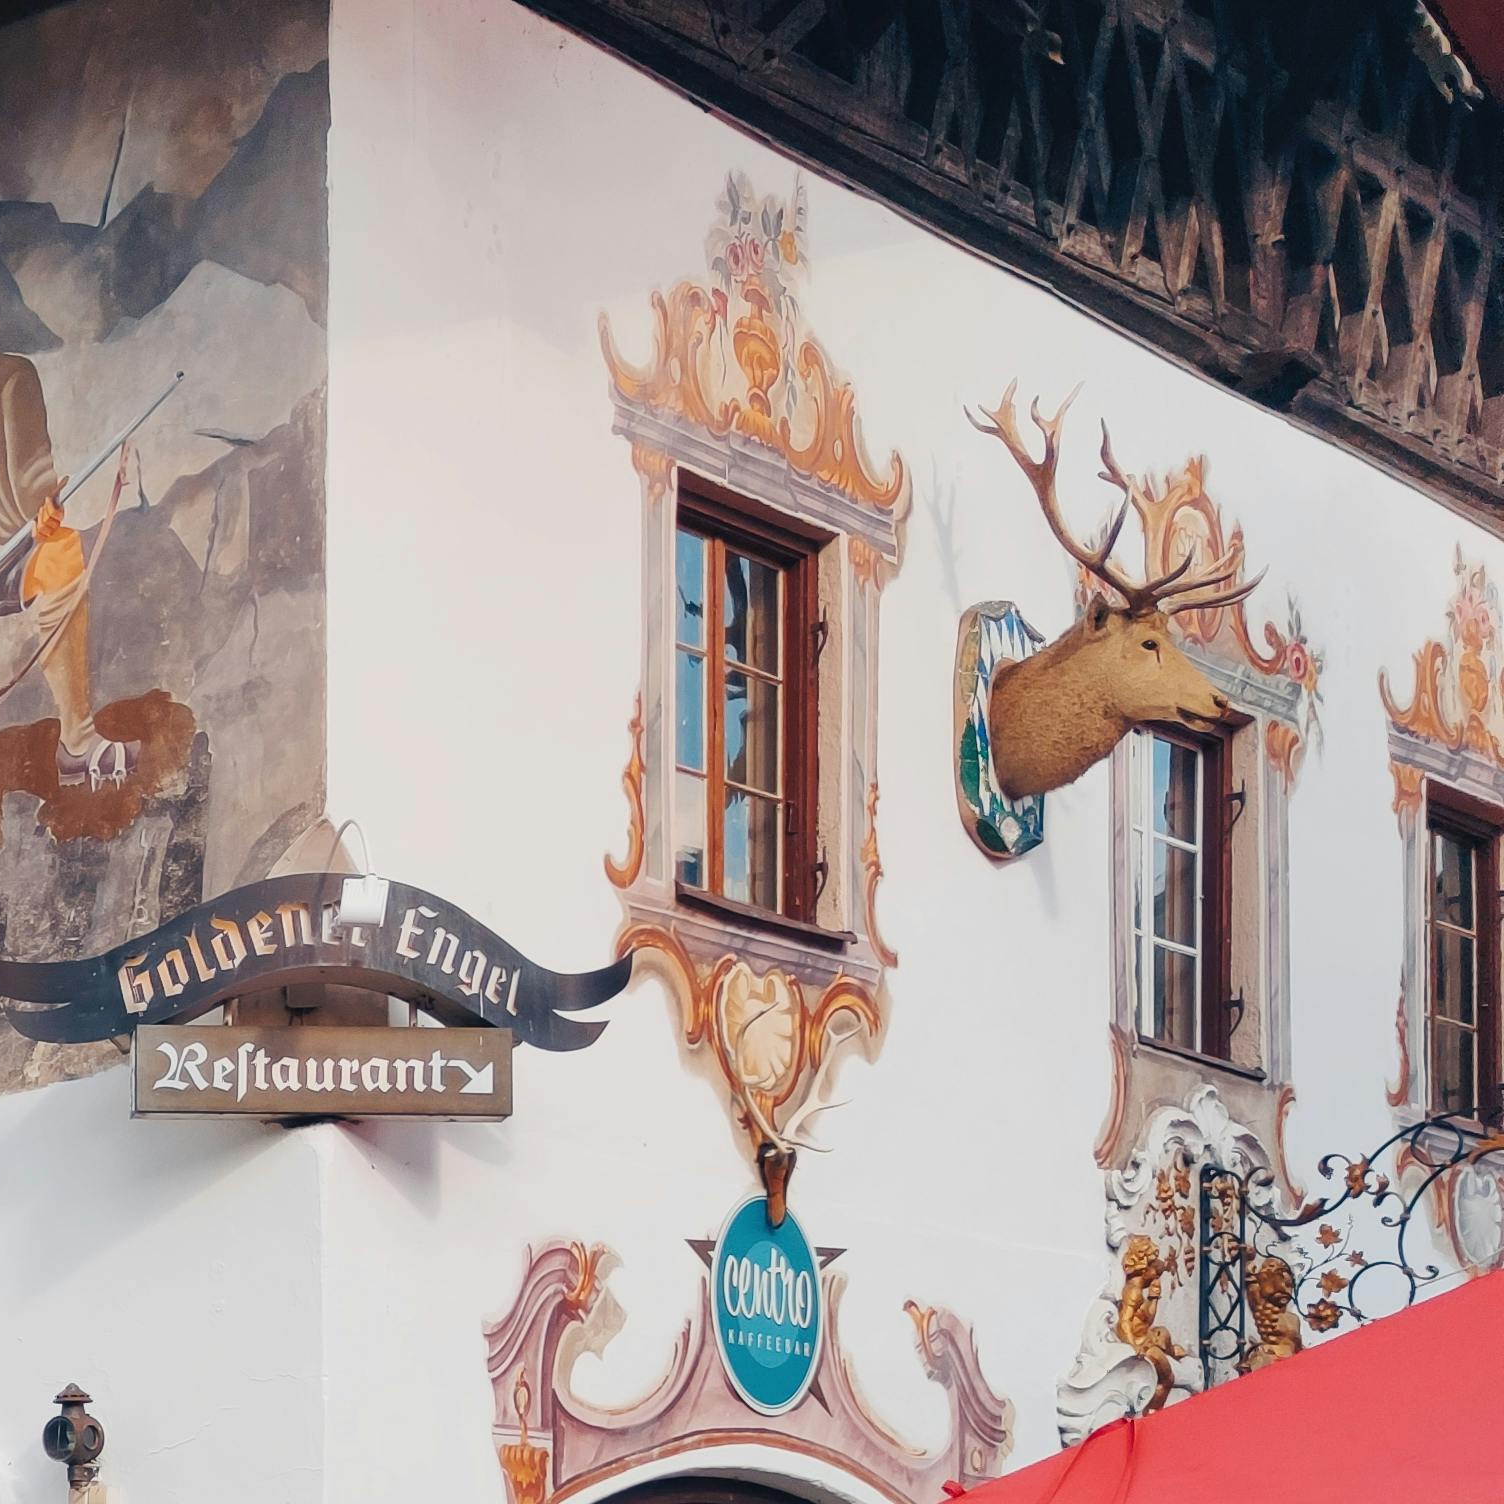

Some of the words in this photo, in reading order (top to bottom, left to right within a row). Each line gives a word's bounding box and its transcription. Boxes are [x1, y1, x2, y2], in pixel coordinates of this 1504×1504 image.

[397, 904, 522, 1017] Engel
[723, 1247, 813, 1330] centro
[728, 1328, 811, 1358] KAFFEEBAR
